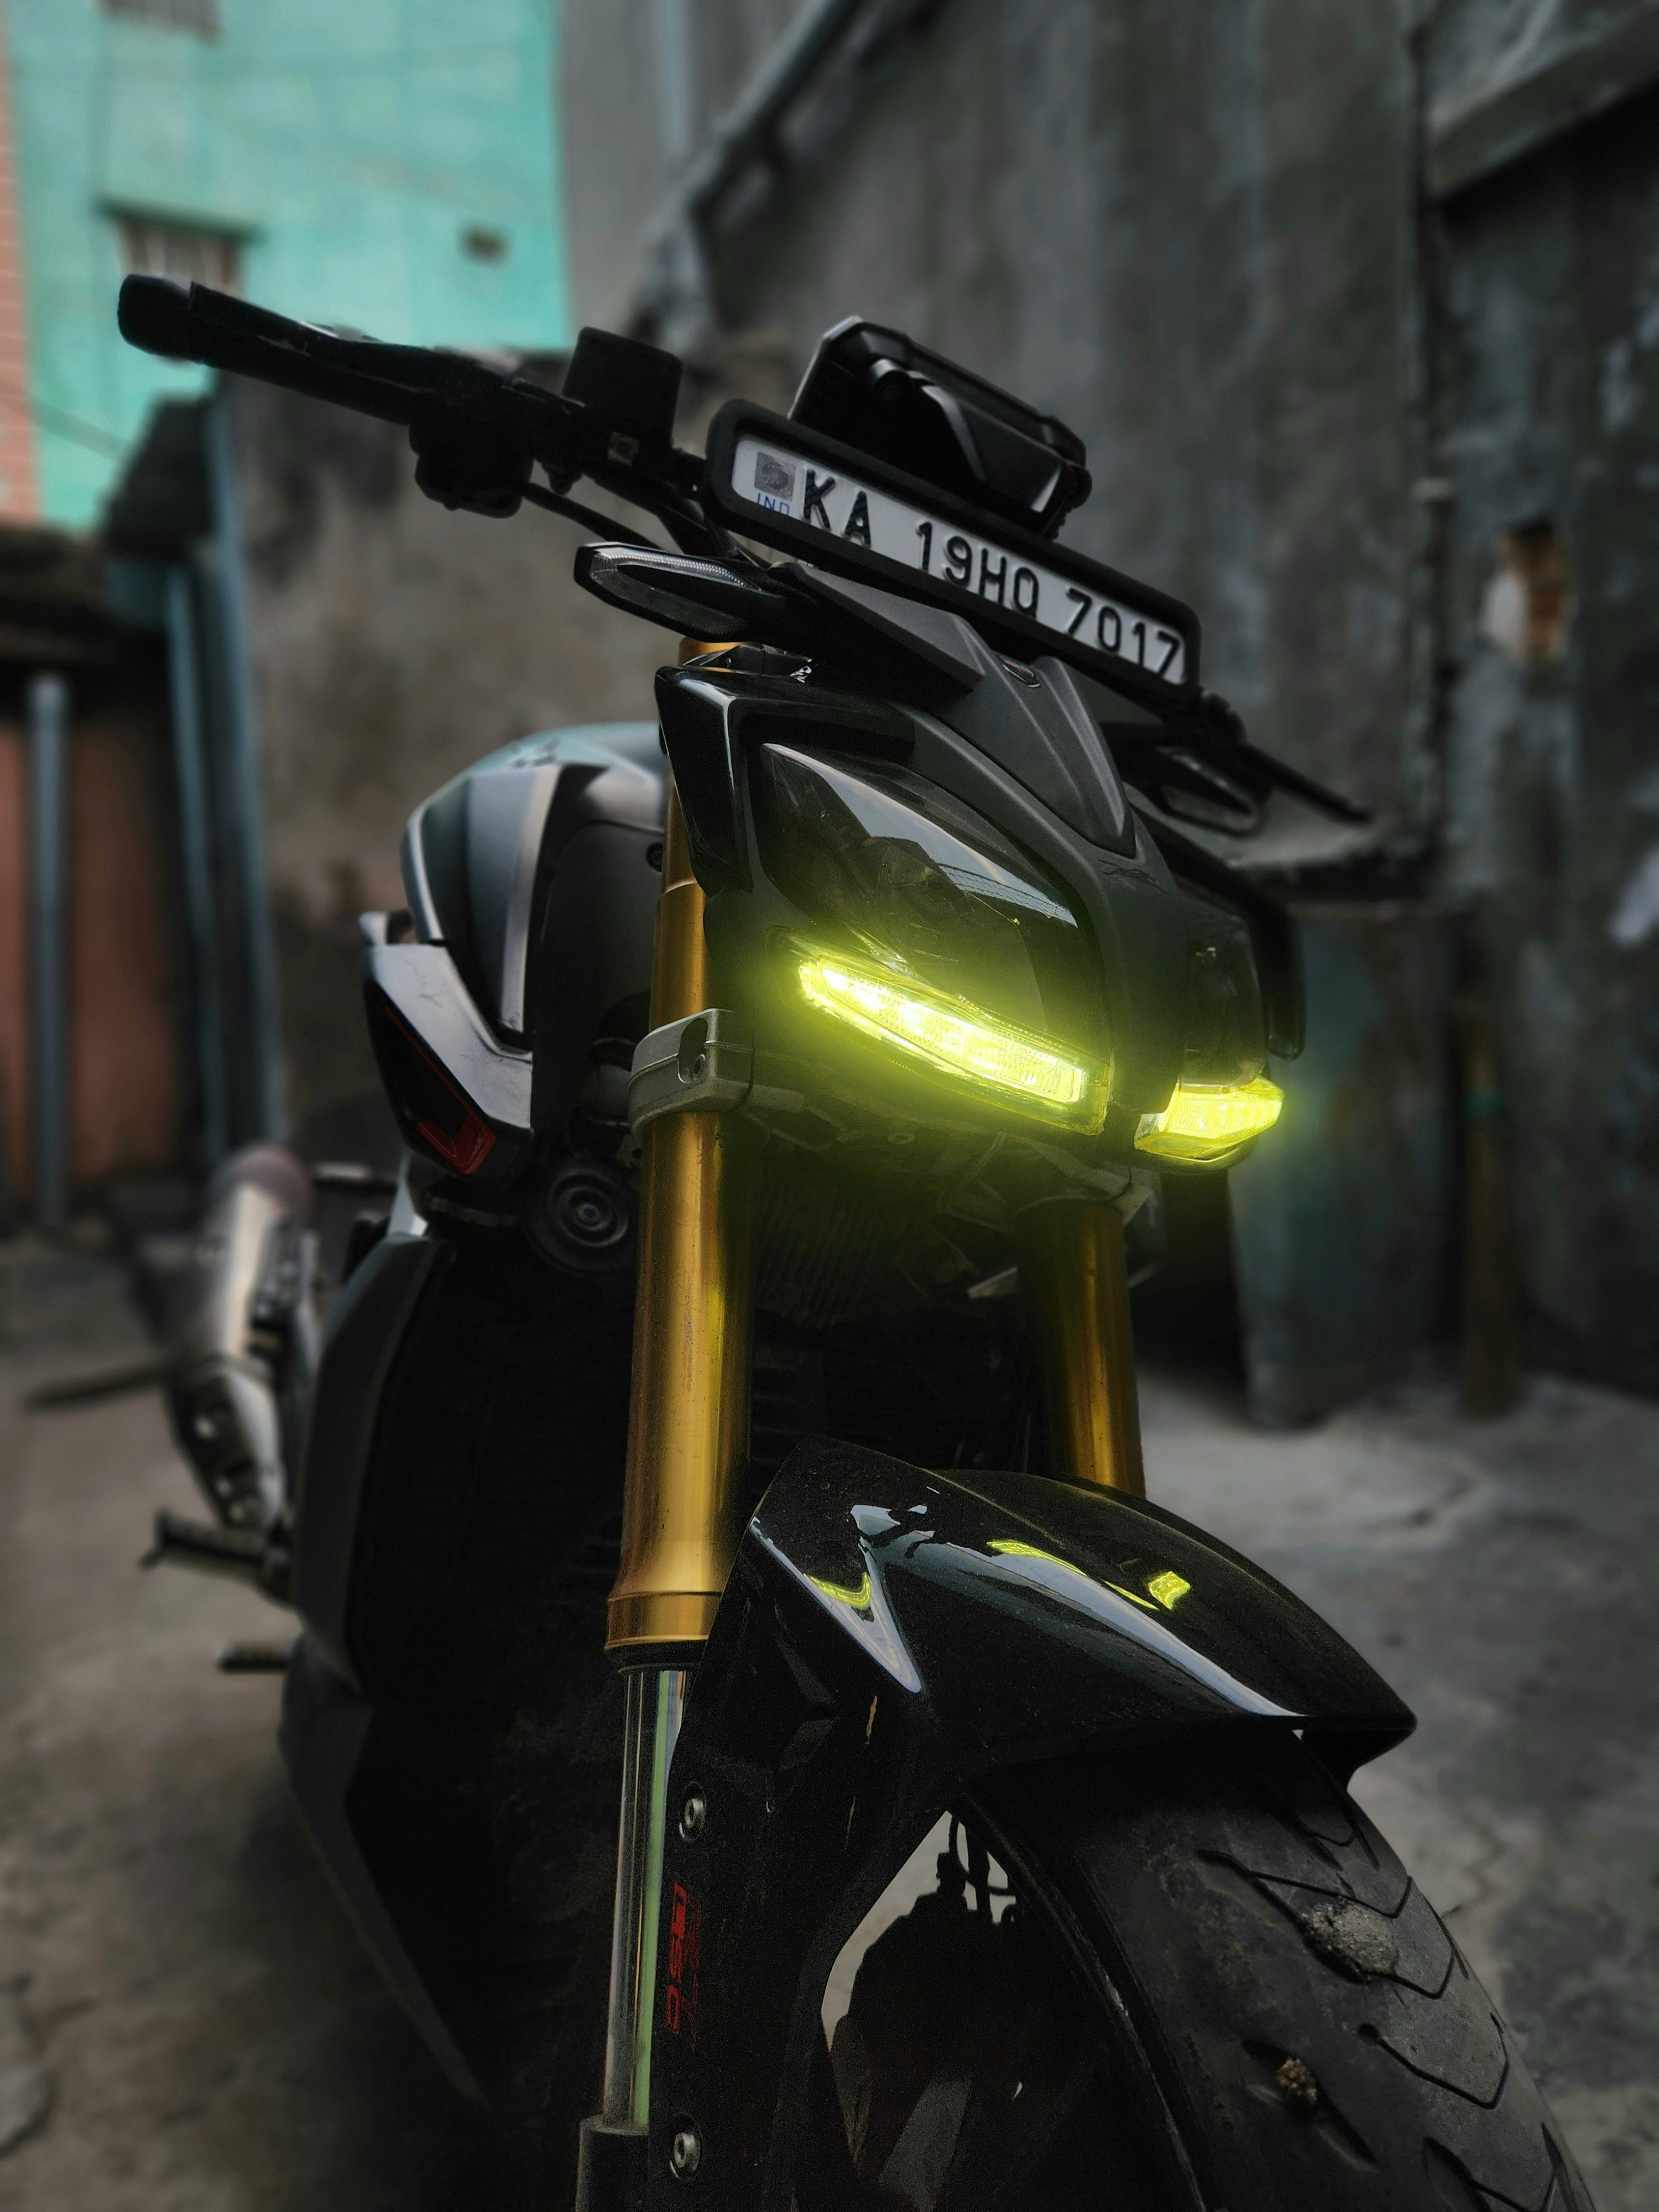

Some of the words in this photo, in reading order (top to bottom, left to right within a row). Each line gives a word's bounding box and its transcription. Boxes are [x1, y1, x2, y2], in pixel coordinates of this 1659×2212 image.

[803, 469, 872, 547] KA
[918, 521, 1039, 621] 19HQ
[1067, 587, 1180, 676] 7017
